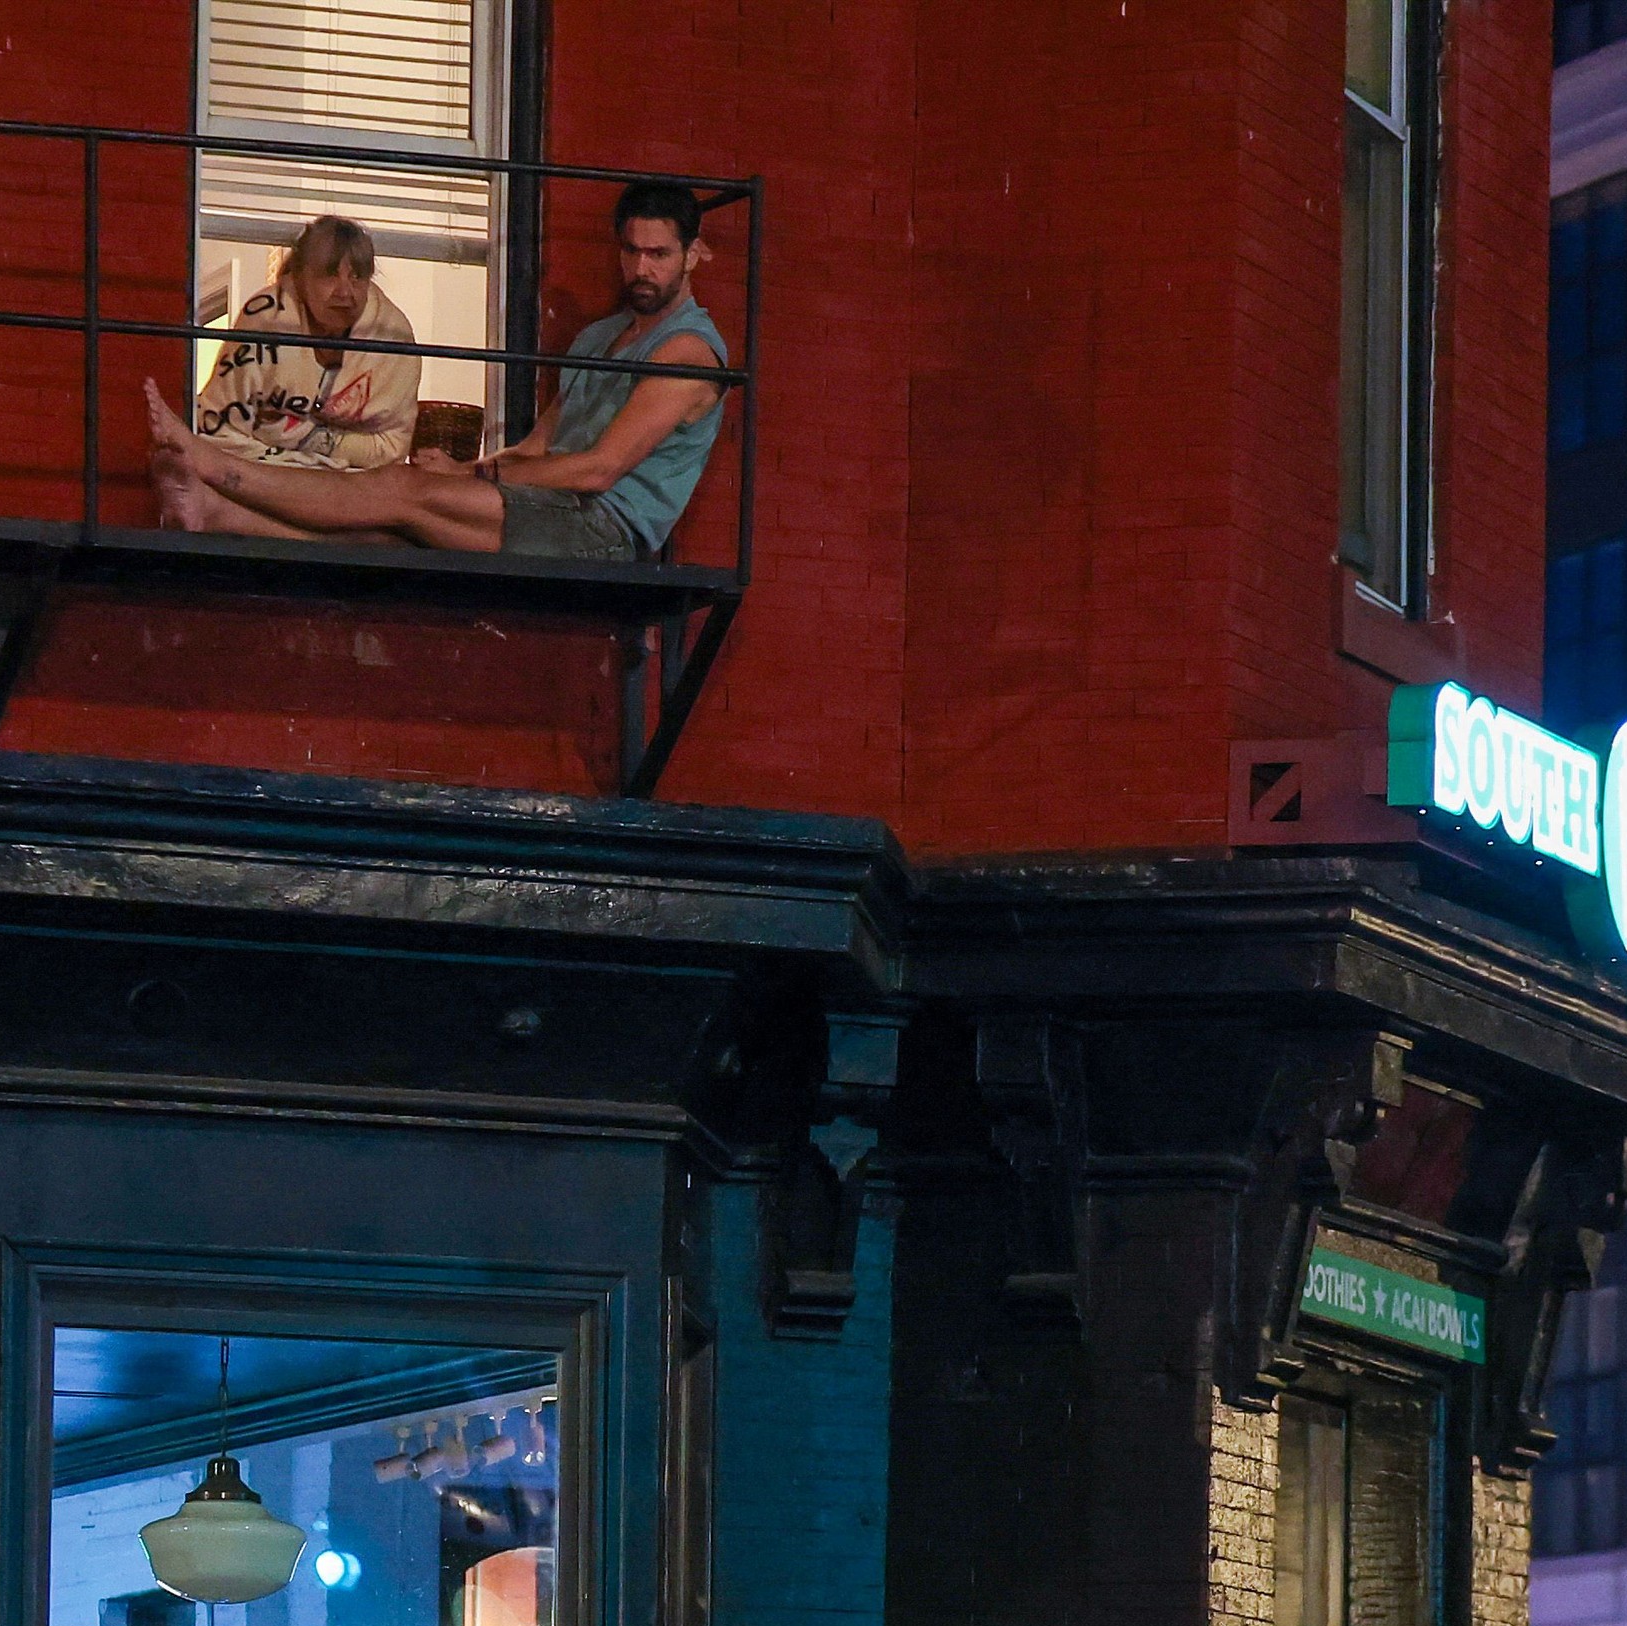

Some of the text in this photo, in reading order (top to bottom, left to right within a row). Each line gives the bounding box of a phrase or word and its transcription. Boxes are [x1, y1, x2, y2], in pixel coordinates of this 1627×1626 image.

[1435, 690, 1596, 868] SOUTH
[1391, 1288, 1425, 1332] ACAI
[1428, 1302, 1480, 1349] BOWLS
